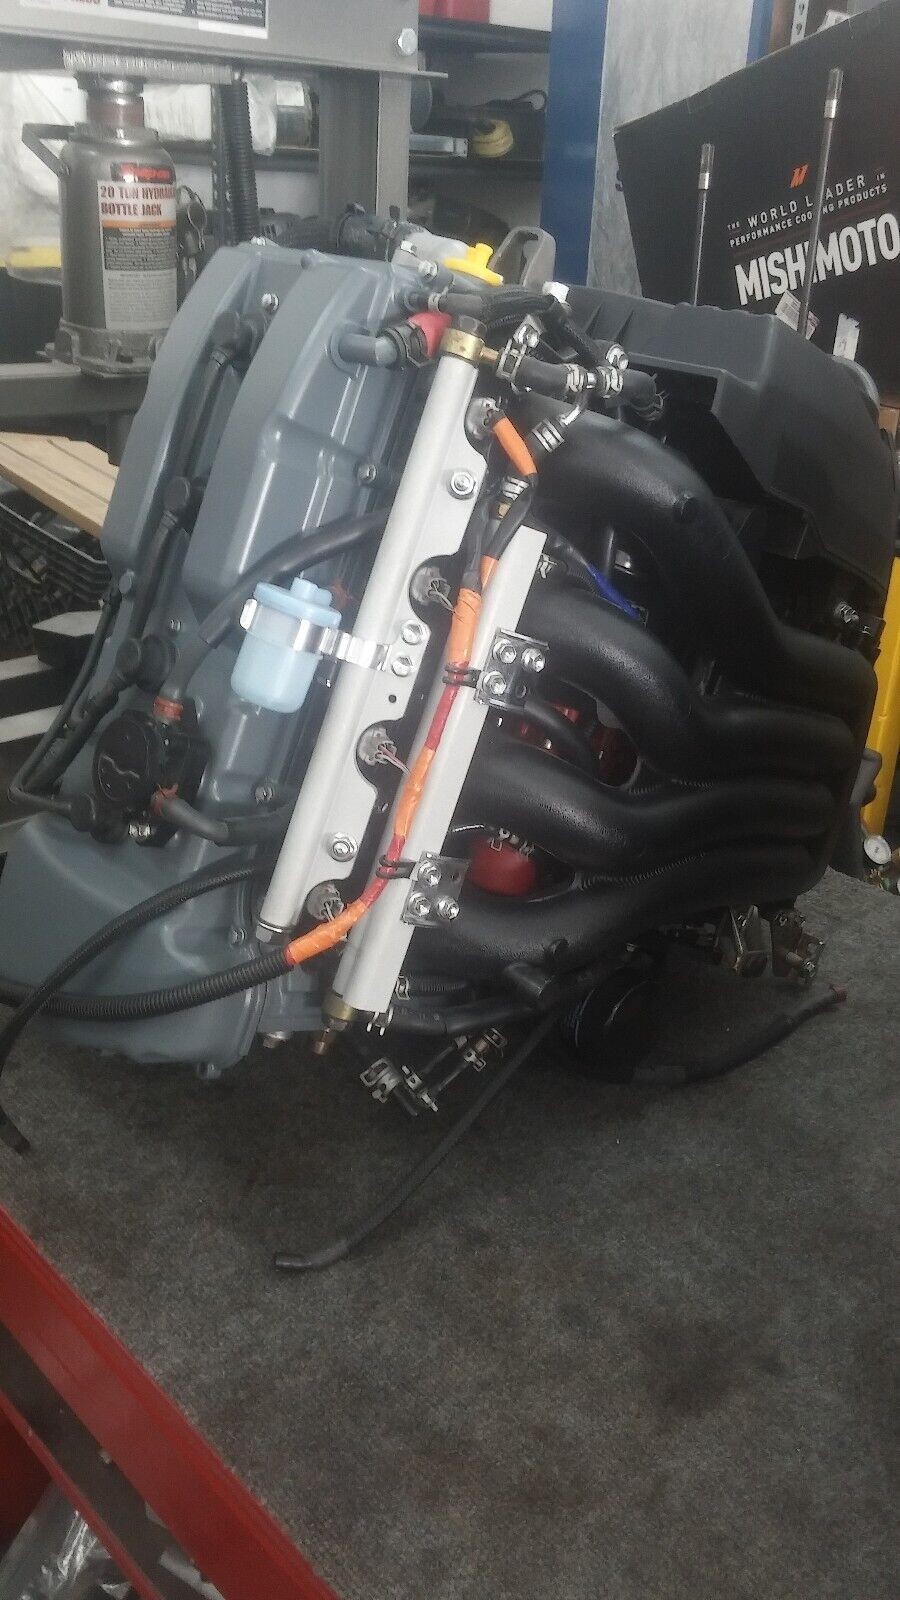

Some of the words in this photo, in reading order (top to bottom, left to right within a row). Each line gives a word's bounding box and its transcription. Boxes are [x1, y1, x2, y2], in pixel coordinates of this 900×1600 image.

[100, 185, 115, 199] 20
[100, 202, 138, 216] BOTTLE
[142, 203, 162, 216] JACK
[729, 218, 793, 248] PERFORMANCE
[795, 203, 834, 225] COONG
[837, 183, 888, 209] PRODUCTS
[747, 200, 798, 229] WORLD
[805, 174, 866, 207] LADER
[734, 213, 900, 306] MISHMOTO
